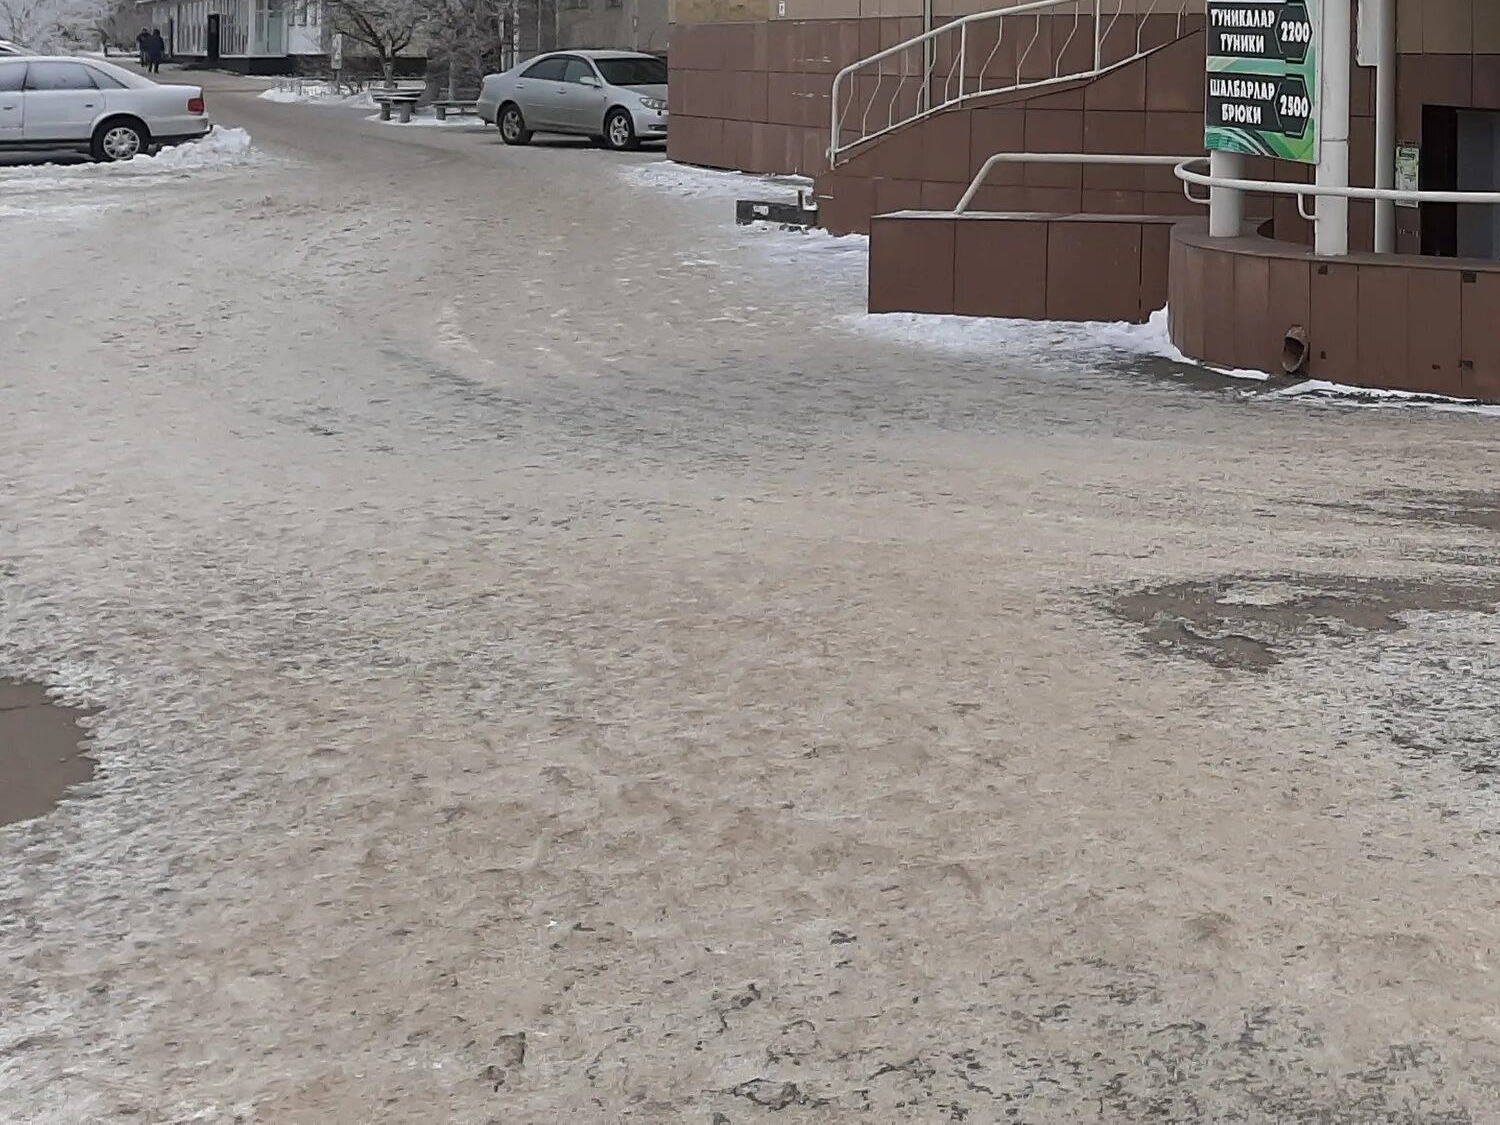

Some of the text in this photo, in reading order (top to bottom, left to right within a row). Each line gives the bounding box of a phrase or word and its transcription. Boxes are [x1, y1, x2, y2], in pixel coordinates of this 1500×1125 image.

[1210, 8, 1276, 29] ТУНИКАЛАР
[1280, 21, 1310, 43] 2200
[1220, 33, 1265, 54] ТУНИКИ
[1209, 78, 1276, 101] ШАЛБАРЛАР
[1221, 102, 1263, 125] БРЮКИ
[1279, 94, 1309, 118] 2500
